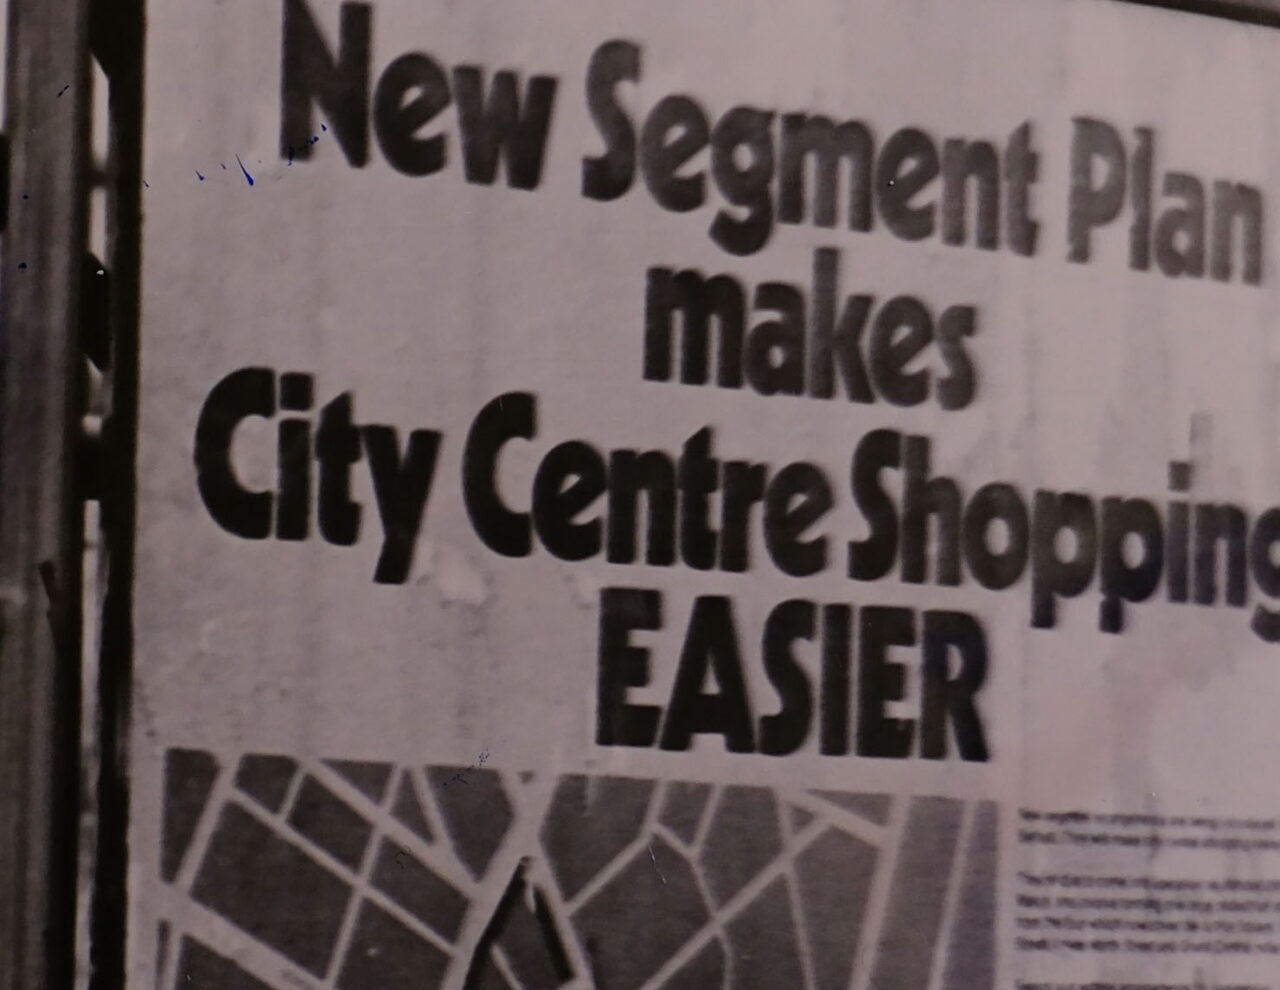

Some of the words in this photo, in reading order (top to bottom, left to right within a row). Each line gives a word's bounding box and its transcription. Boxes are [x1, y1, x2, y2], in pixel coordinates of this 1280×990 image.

[280, 0, 558, 191] New
[581, 39, 1040, 257] Segment
[1066, 115, 1265, 287] Plan
[643, 247, 978, 411] makes
[194, 366, 442, 584] City
[462, 391, 835, 577] Centre
[596, 587, 991, 762] EASIER
